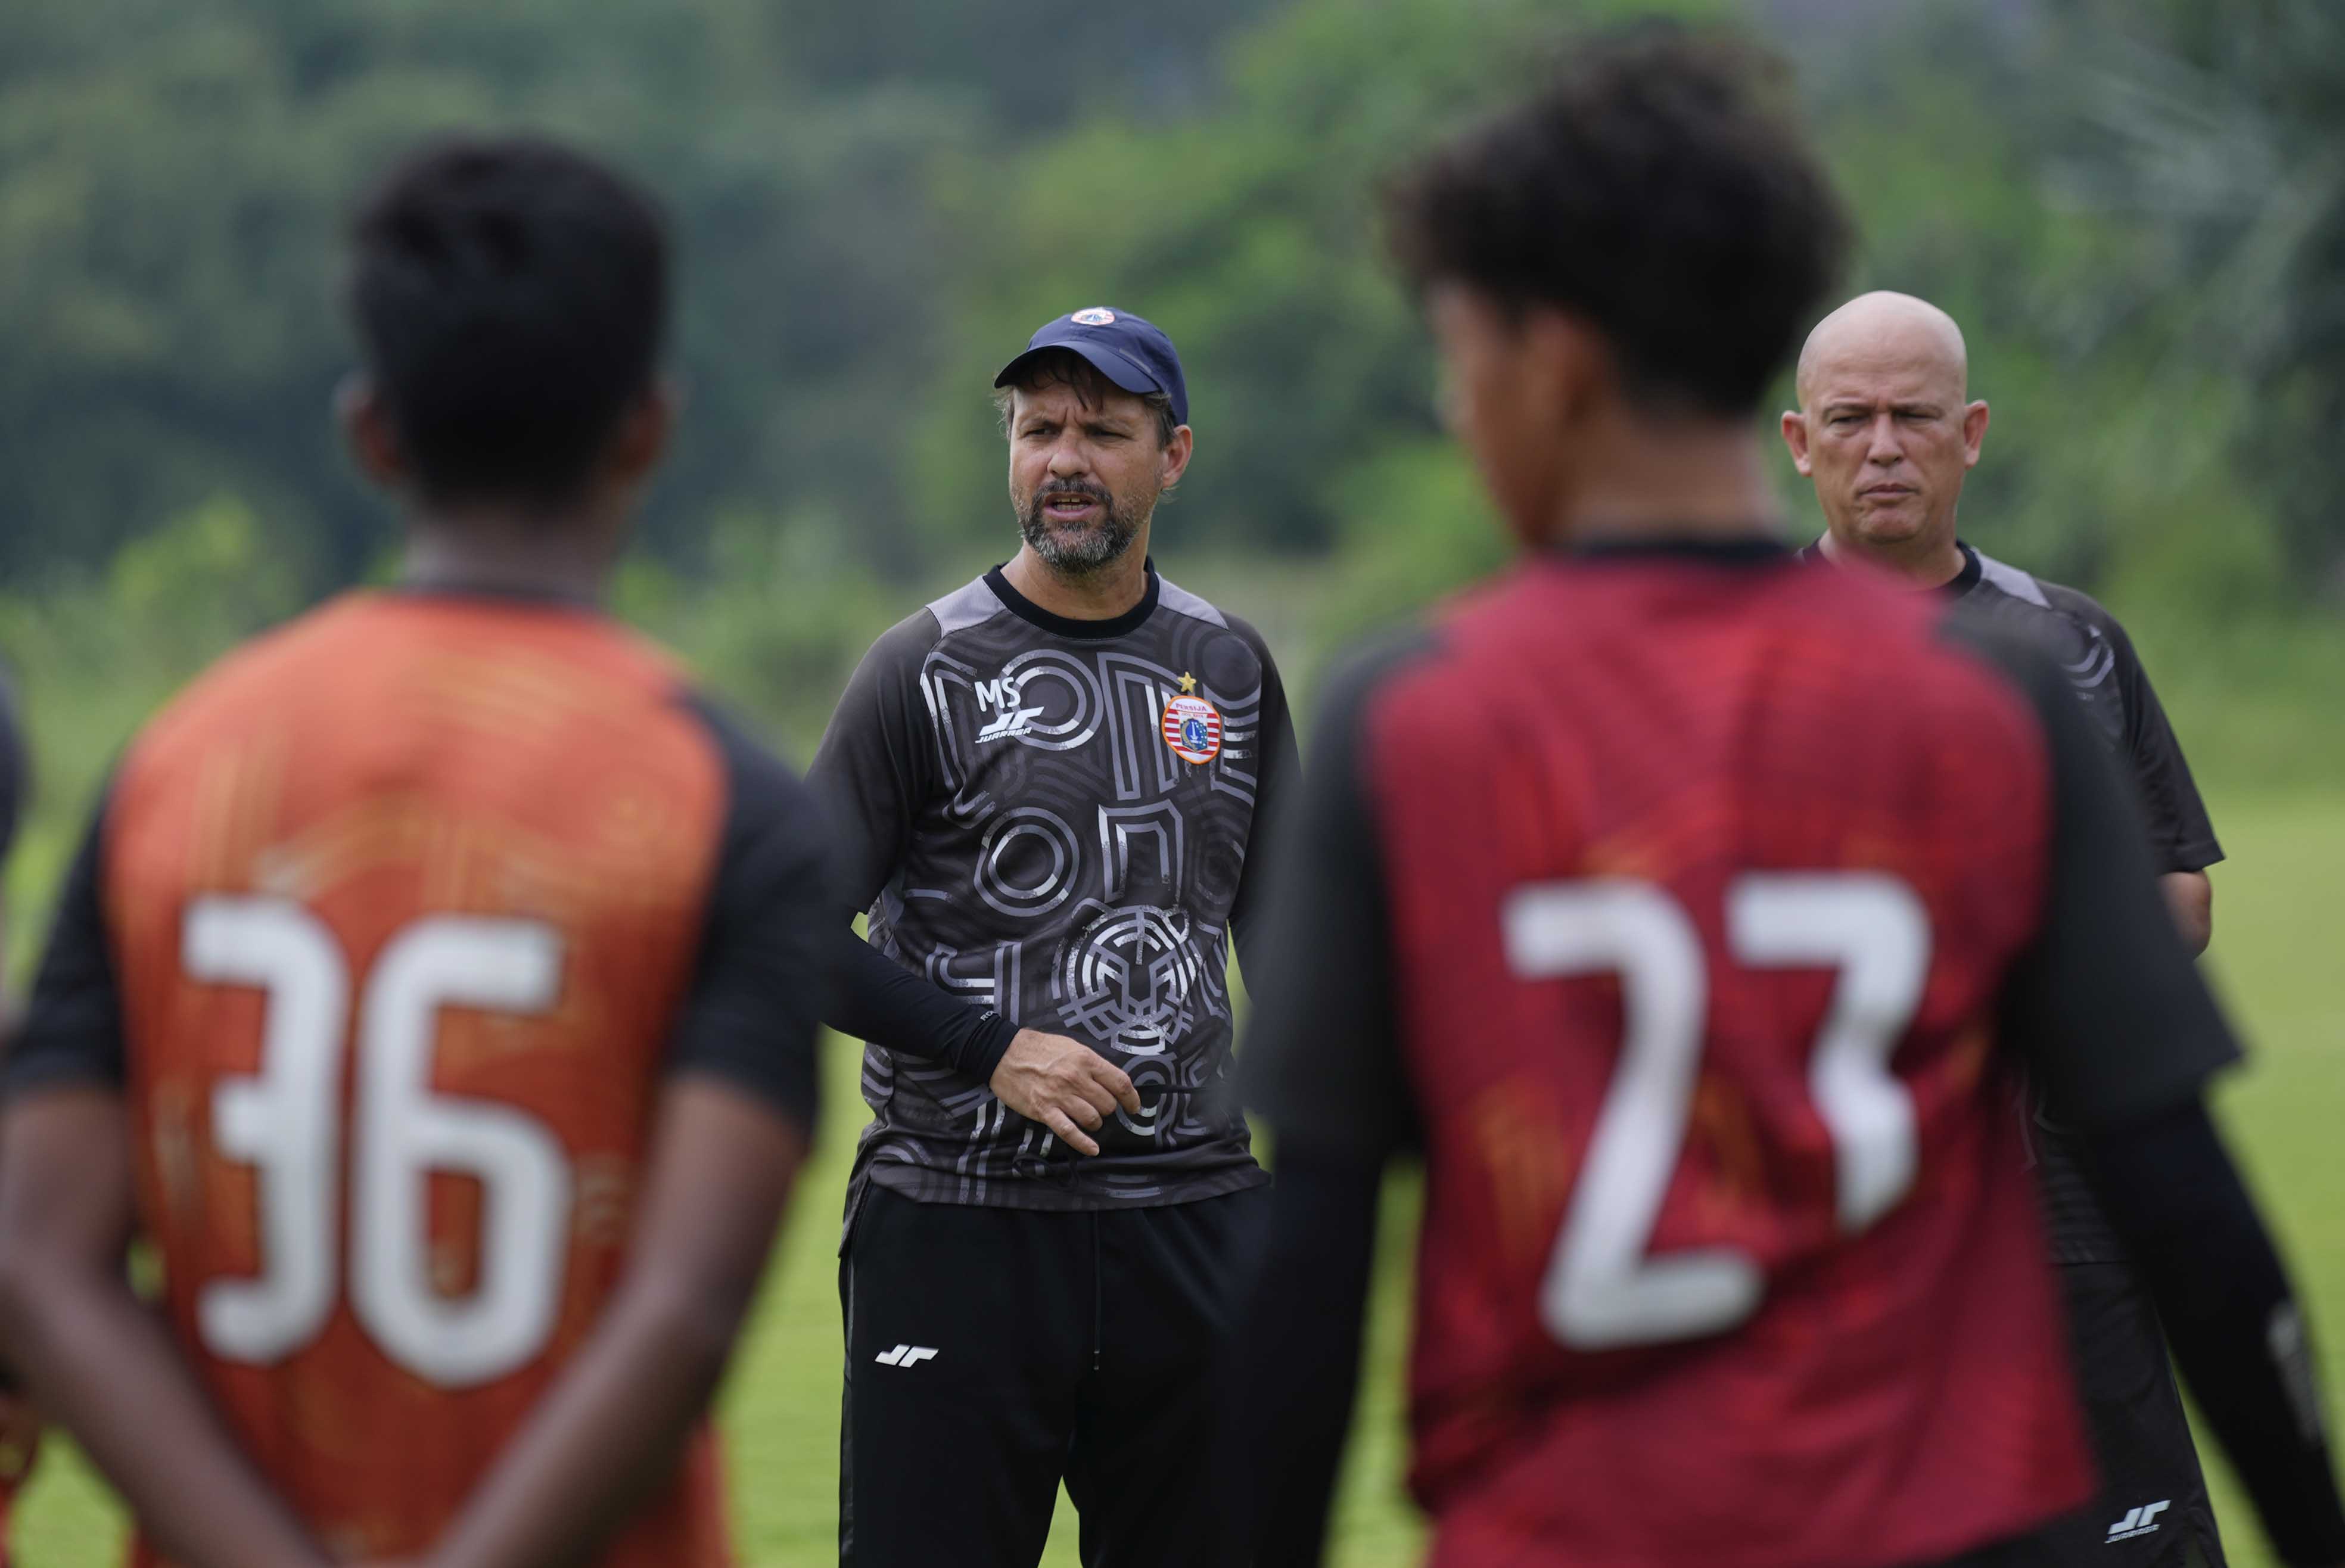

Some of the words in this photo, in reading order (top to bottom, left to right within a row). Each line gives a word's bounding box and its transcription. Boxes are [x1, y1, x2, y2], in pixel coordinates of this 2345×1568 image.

[975, 676, 1021, 712] MS
[1175, 703, 1206, 711] PERSIJA
[181, 894, 573, 1387] 36
